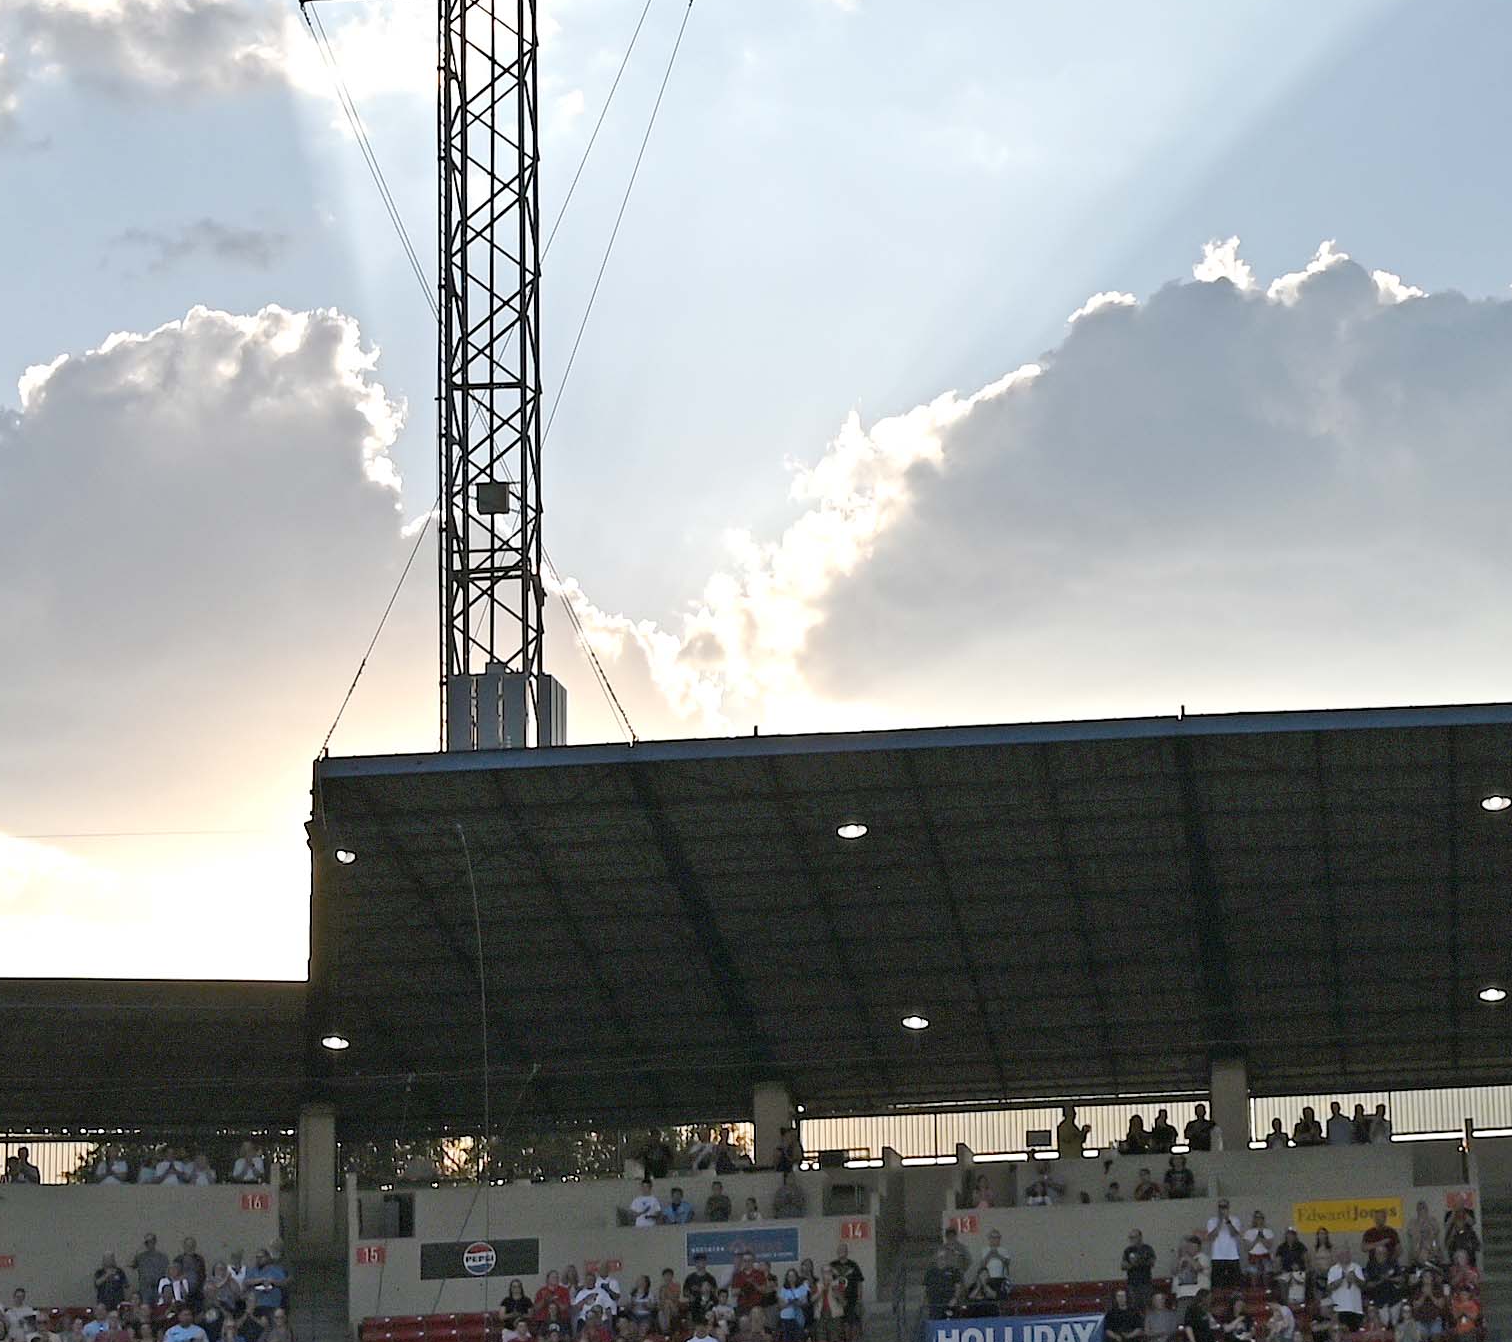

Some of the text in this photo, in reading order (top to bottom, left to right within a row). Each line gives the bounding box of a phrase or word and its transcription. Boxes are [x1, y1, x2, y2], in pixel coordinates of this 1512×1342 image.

[247, 1194, 262, 1210] 16
[848, 1223, 863, 1238] 14
[957, 1217, 971, 1233] 13
[364, 1247, 379, 1263] 15
